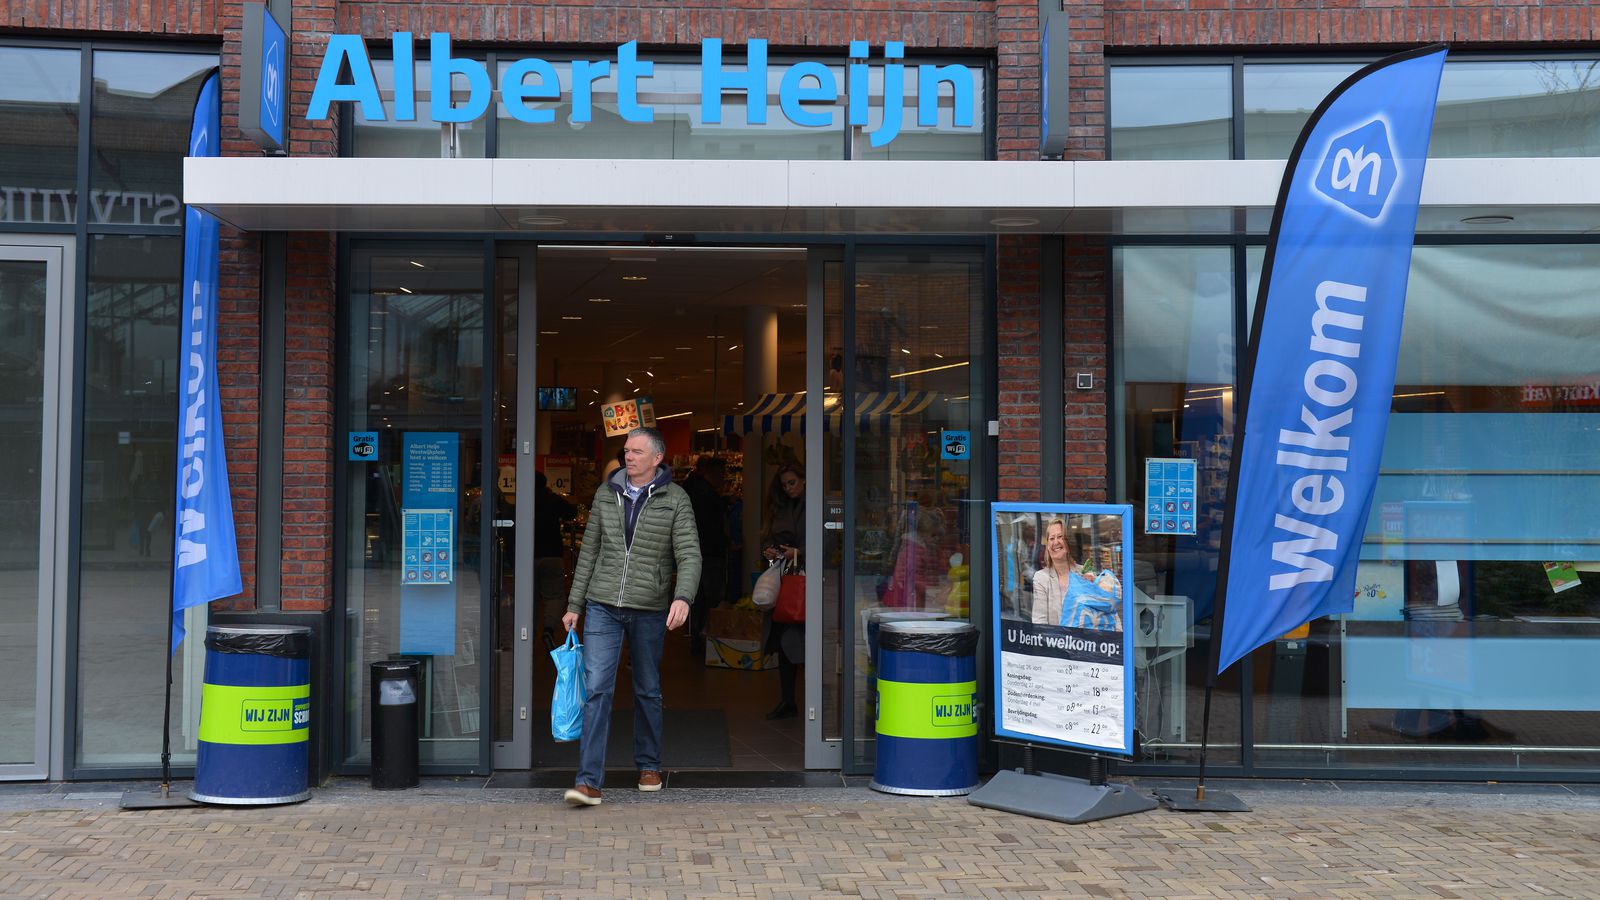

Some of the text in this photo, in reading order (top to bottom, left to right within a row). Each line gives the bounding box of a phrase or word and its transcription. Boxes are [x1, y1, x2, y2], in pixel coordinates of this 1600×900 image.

[305, 31, 973, 148] Albert Heijn
[353, 435, 375, 443] Gratis
[945, 434, 967, 442] Gratis
[1268, 278, 1368, 593] Welkom
[1007, 629, 1121, 657] U bent welkom op:
[245, 708, 290, 722] WIJ ZIJN
[935, 704, 953, 718] WIJ
[954, 703, 971, 717] ZIJN
